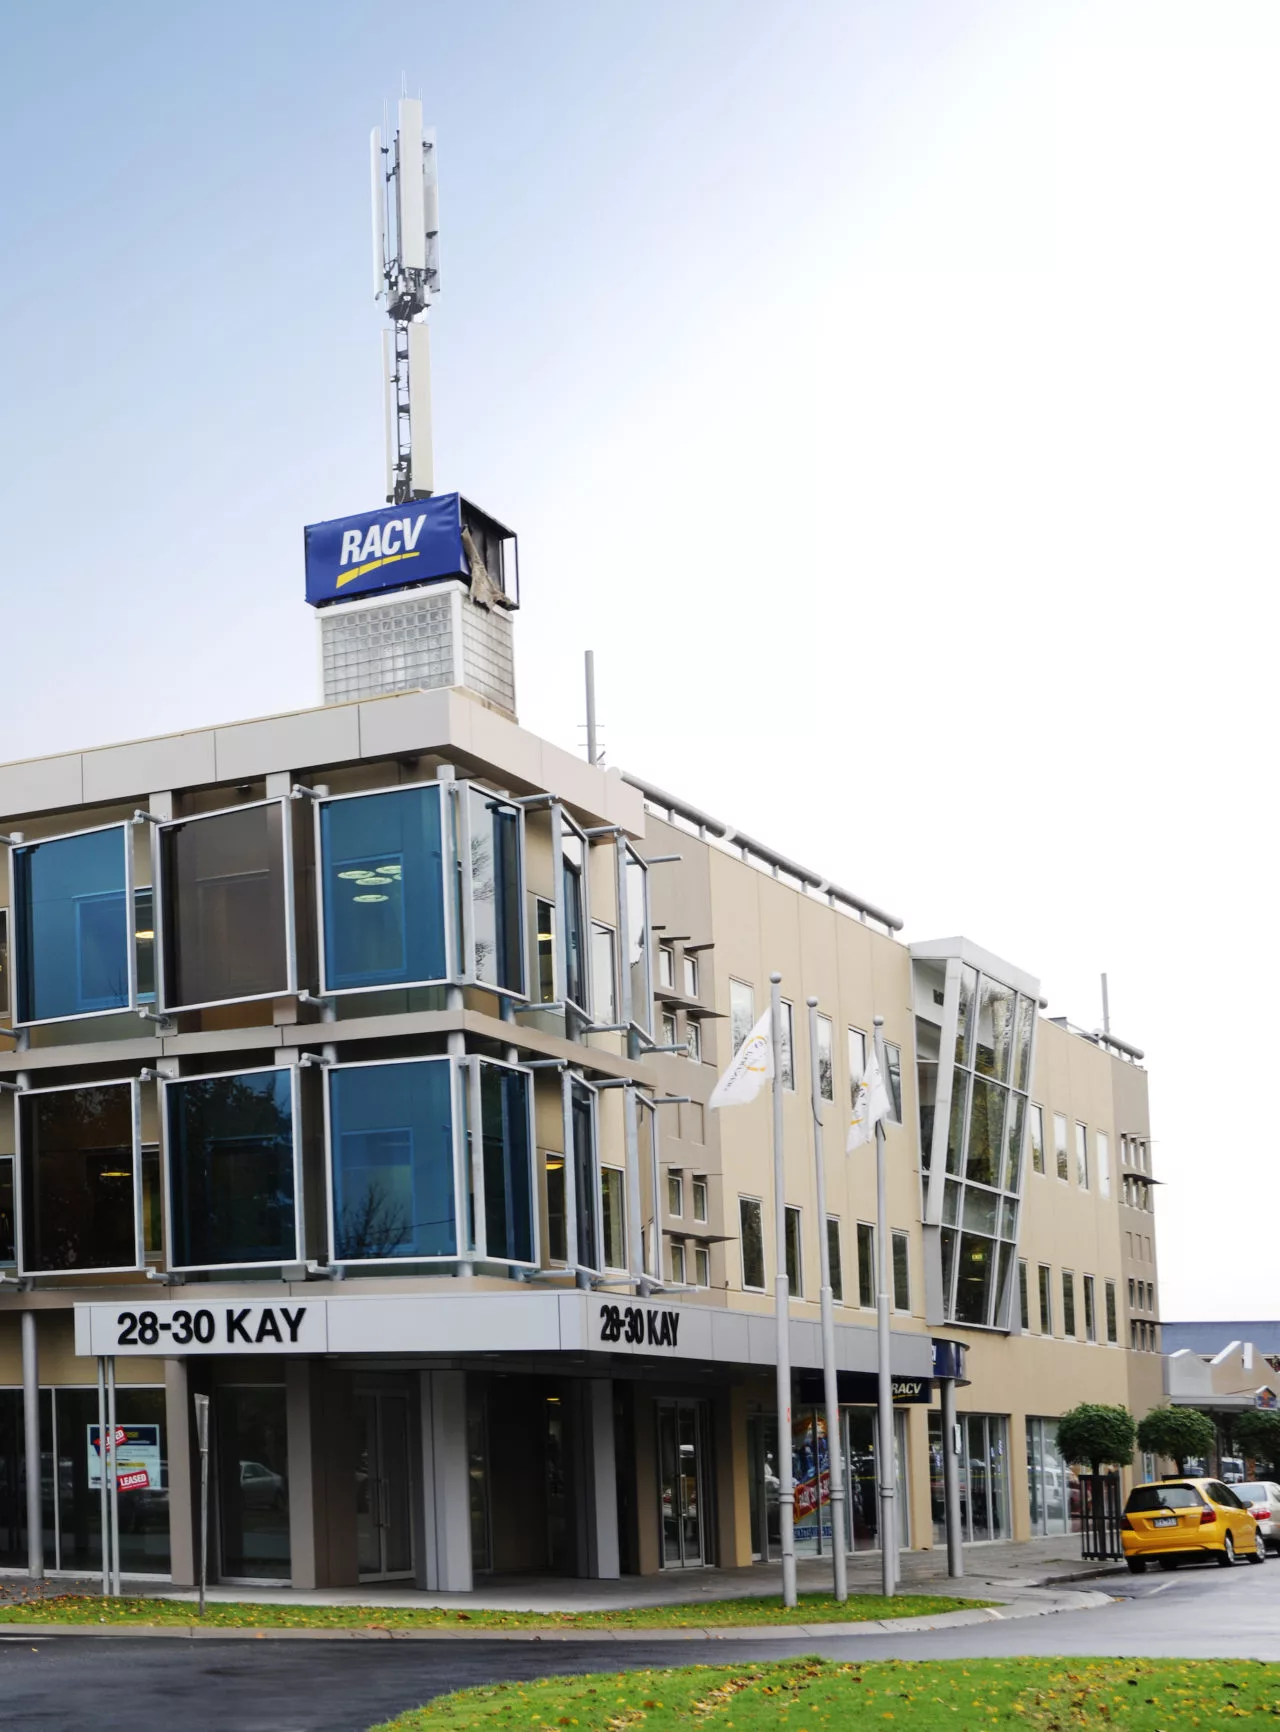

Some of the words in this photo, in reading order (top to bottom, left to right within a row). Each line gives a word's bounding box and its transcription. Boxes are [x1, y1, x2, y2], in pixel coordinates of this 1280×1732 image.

[339, 514, 427, 566] RACV
[117, 1309, 216, 1346] 28-30
[226, 1307, 307, 1343] KAY
[600, 1304, 645, 1344] 28-30
[646, 1309, 680, 1347] KAY
[891, 1382, 922, 1394] RACV
[120, 1473, 147, 1487] LEASED
